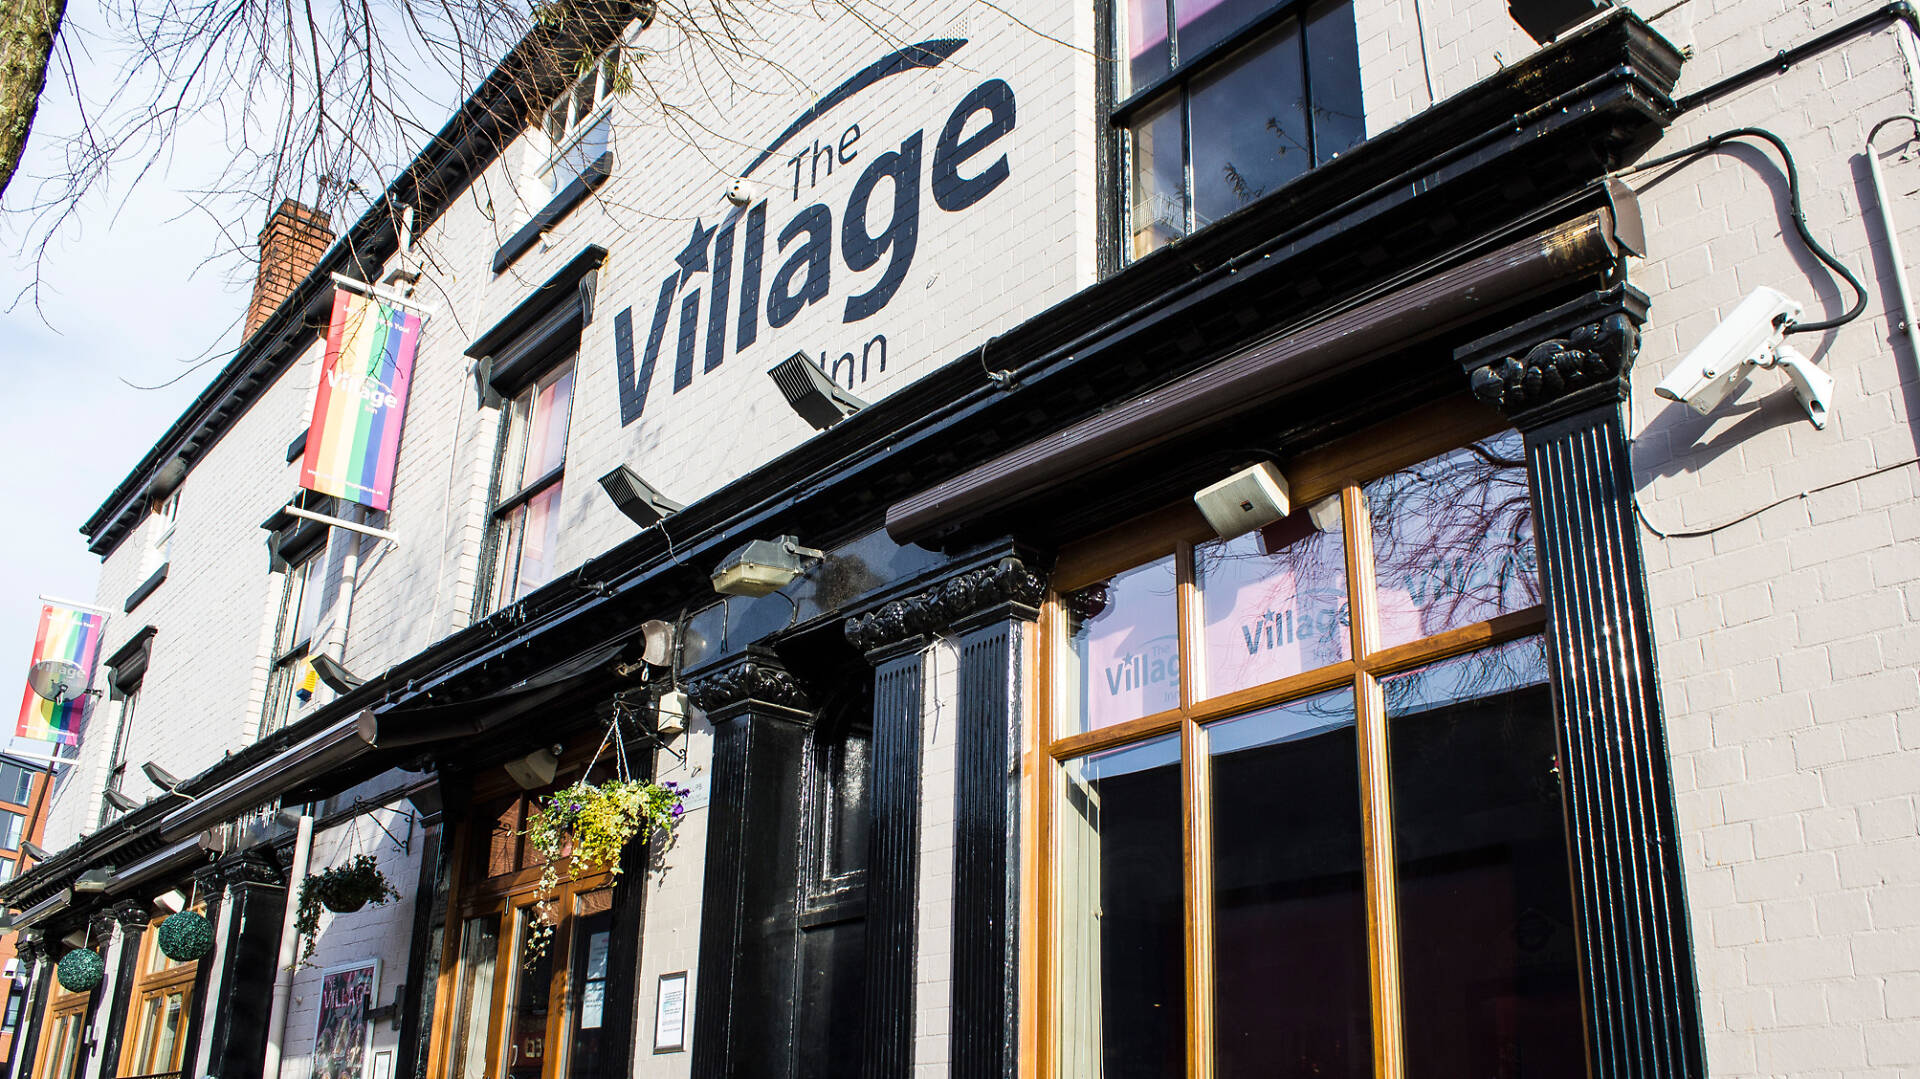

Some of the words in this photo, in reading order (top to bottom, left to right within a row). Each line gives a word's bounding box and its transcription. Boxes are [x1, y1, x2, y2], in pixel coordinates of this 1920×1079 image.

[787, 122, 861, 201] The
[614, 78, 1016, 428] Village
[327, 367, 398, 408] Village
